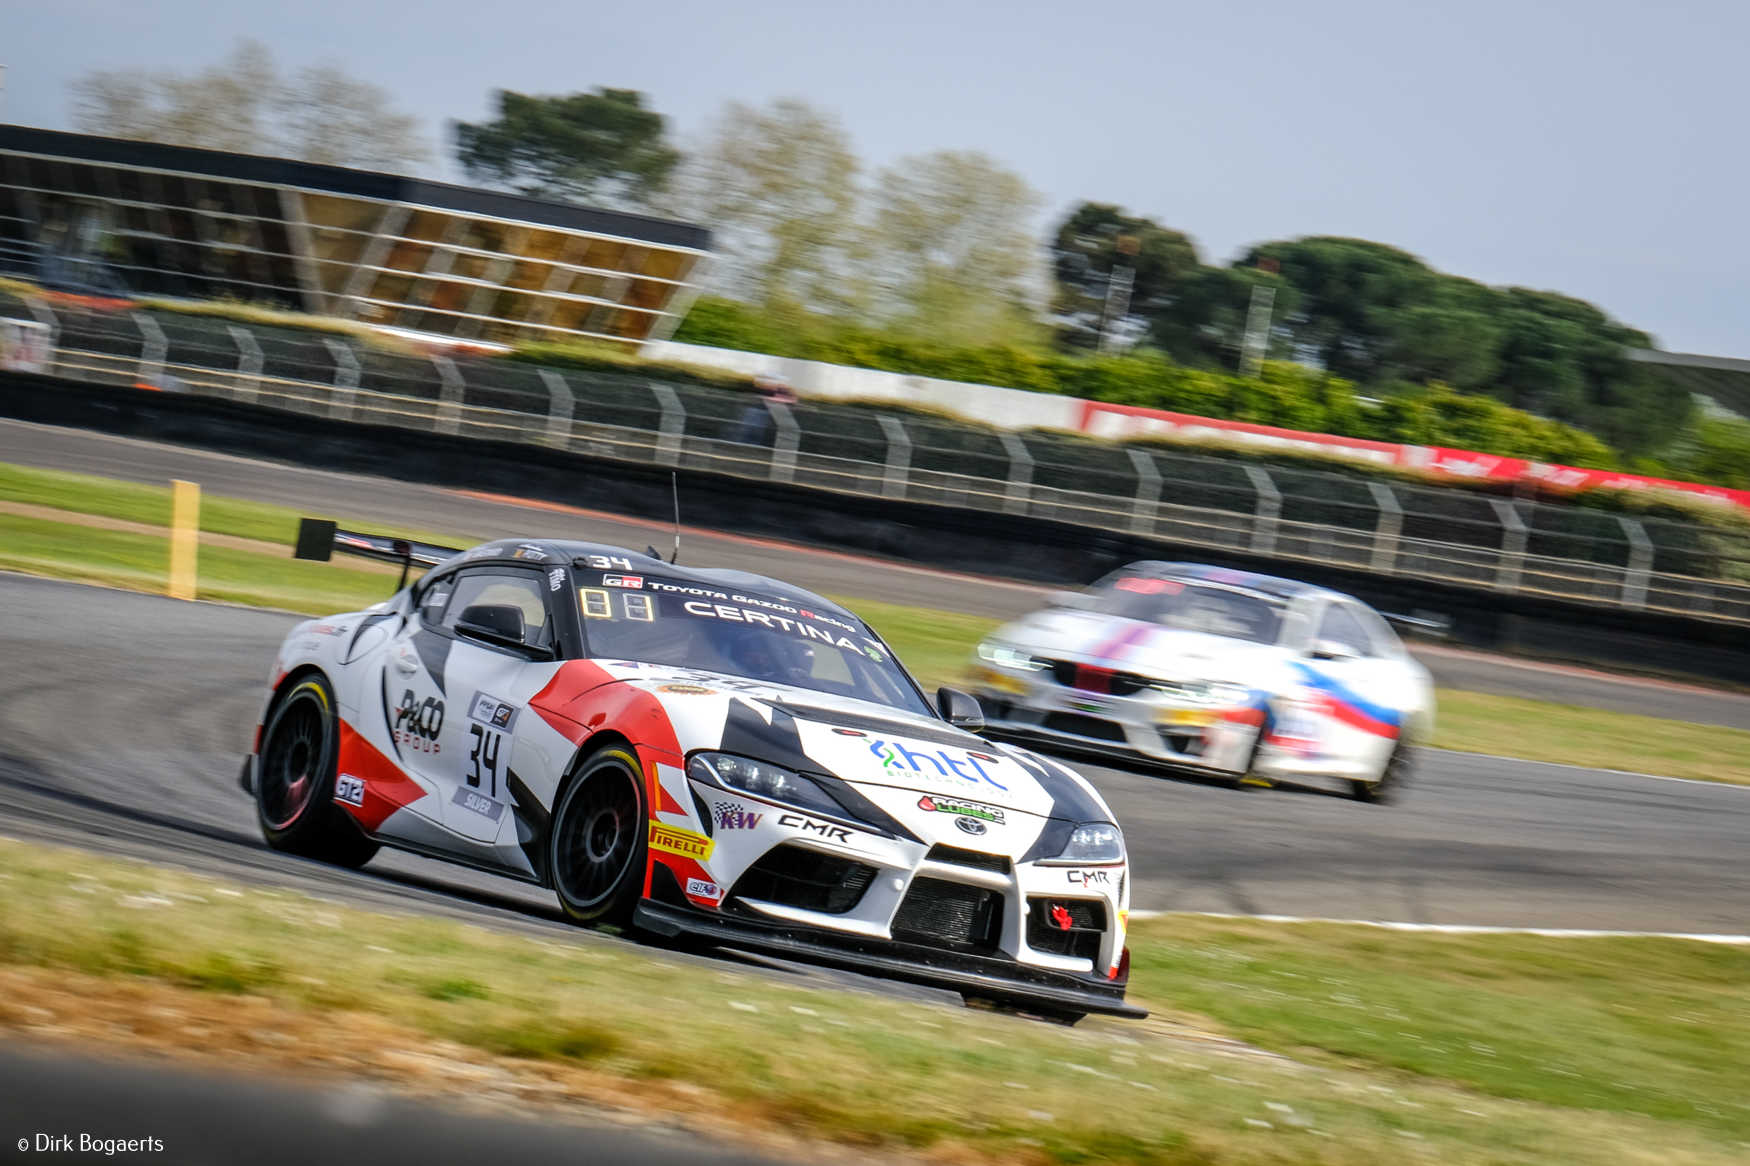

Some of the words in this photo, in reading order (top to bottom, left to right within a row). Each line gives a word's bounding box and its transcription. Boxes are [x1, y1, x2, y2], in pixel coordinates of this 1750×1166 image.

[589, 555, 632, 571] 34
[605, 577, 642, 588] GR
[647, 582, 728, 600] TOYOTA
[732, 594, 797, 614] GAZOO
[684, 601, 866, 656] CERTINA
[466, 723, 501, 798] 34
[464, 792, 492, 815] SILVER
[934, 797, 1005, 819] RACING
[719, 811, 763, 830] KW
[777, 814, 854, 843] CMR
[650, 825, 708, 856] PIRELLI
[1067, 870, 1111, 885] CMR
